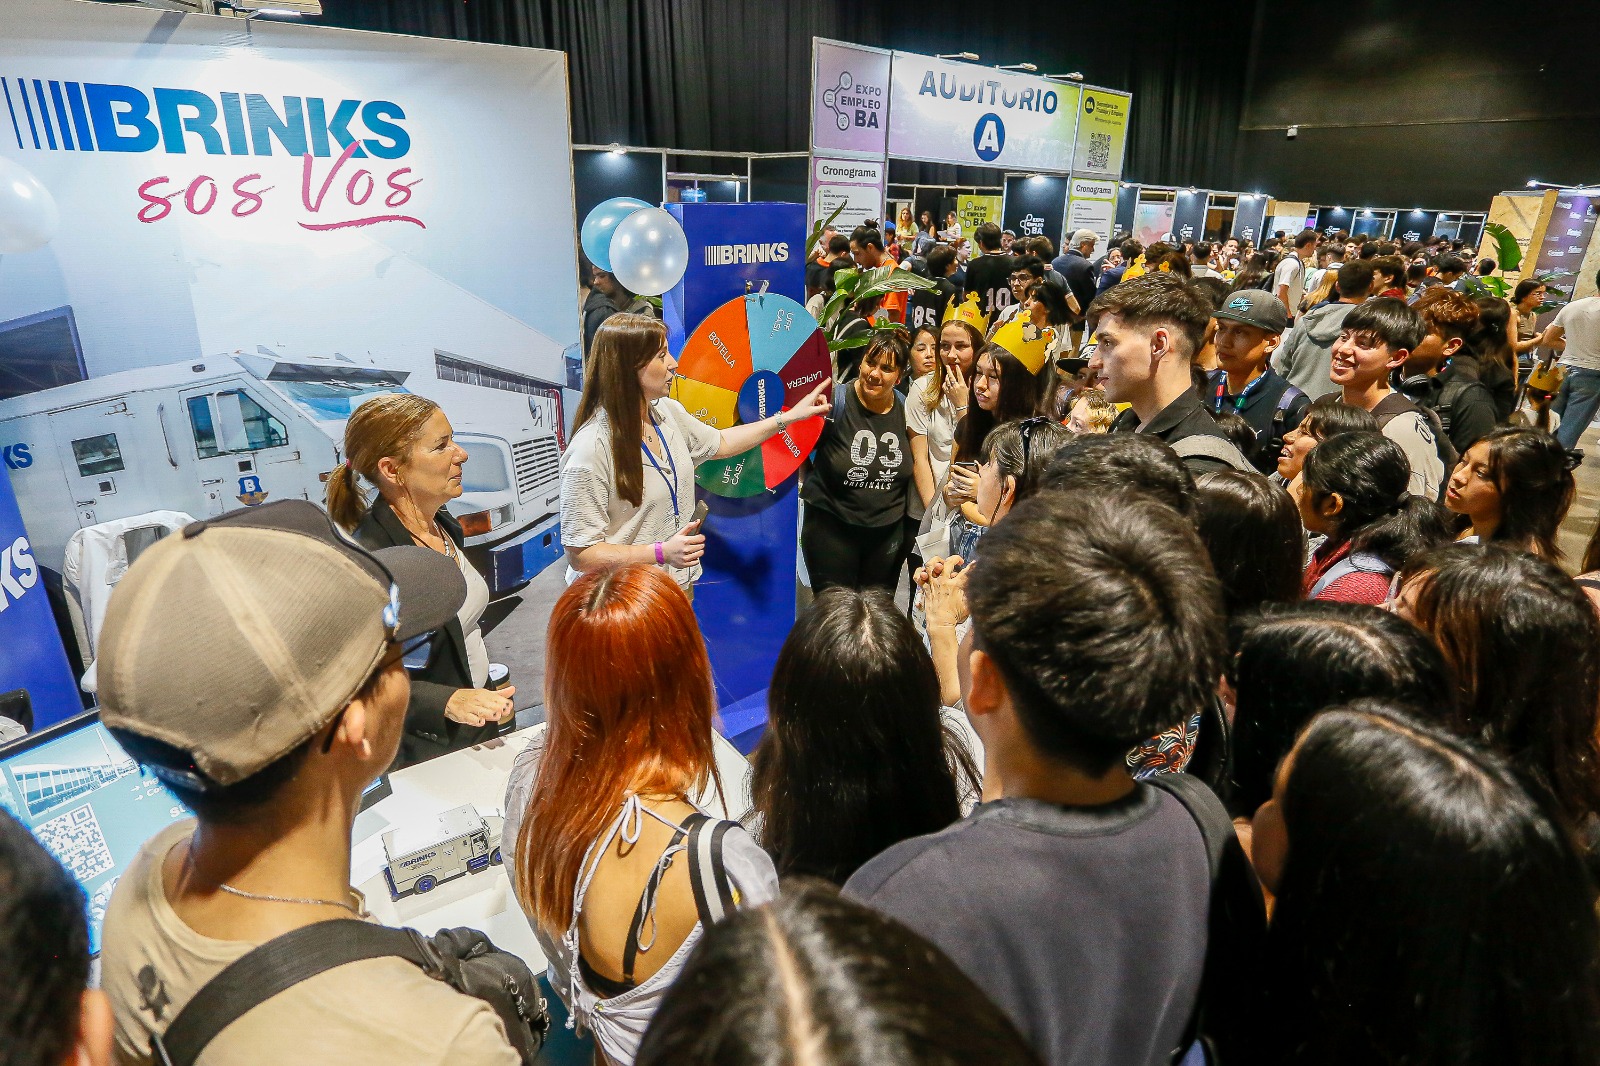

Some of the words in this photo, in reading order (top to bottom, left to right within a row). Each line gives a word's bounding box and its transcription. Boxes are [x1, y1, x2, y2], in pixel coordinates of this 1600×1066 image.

[855, 84, 882, 96] EXPO
[919, 70, 1058, 115] AUDITORIO
[840, 95, 881, 110] EMPLEO
[83, 83, 411, 160] BRINKS
[855, 109, 879, 128] BA
[976, 120, 1000, 152] A
[137, 172, 275, 223] sos
[300, 140, 424, 214] Vos
[822, 165, 877, 179] Cronograma
[1075, 184, 1112, 195] Cronograma
[973, 218, 985, 226] BA
[1031, 226, 1043, 235] BA
[719, 242, 789, 266] BRINKS
[985, 287, 1011, 312] 10
[783, 311, 795, 331] UFF
[708, 331, 736, 369] BOTELLA
[786, 370, 823, 389] LAPICERA
[757, 378, 766, 414] BRINKS
[850, 429, 903, 468] 03
[721, 465, 733, 484] UFF
[243, 479, 256, 493] B
[843, 479, 892, 490] ORIGINALS
[402, 851, 437, 868] BRINKS
